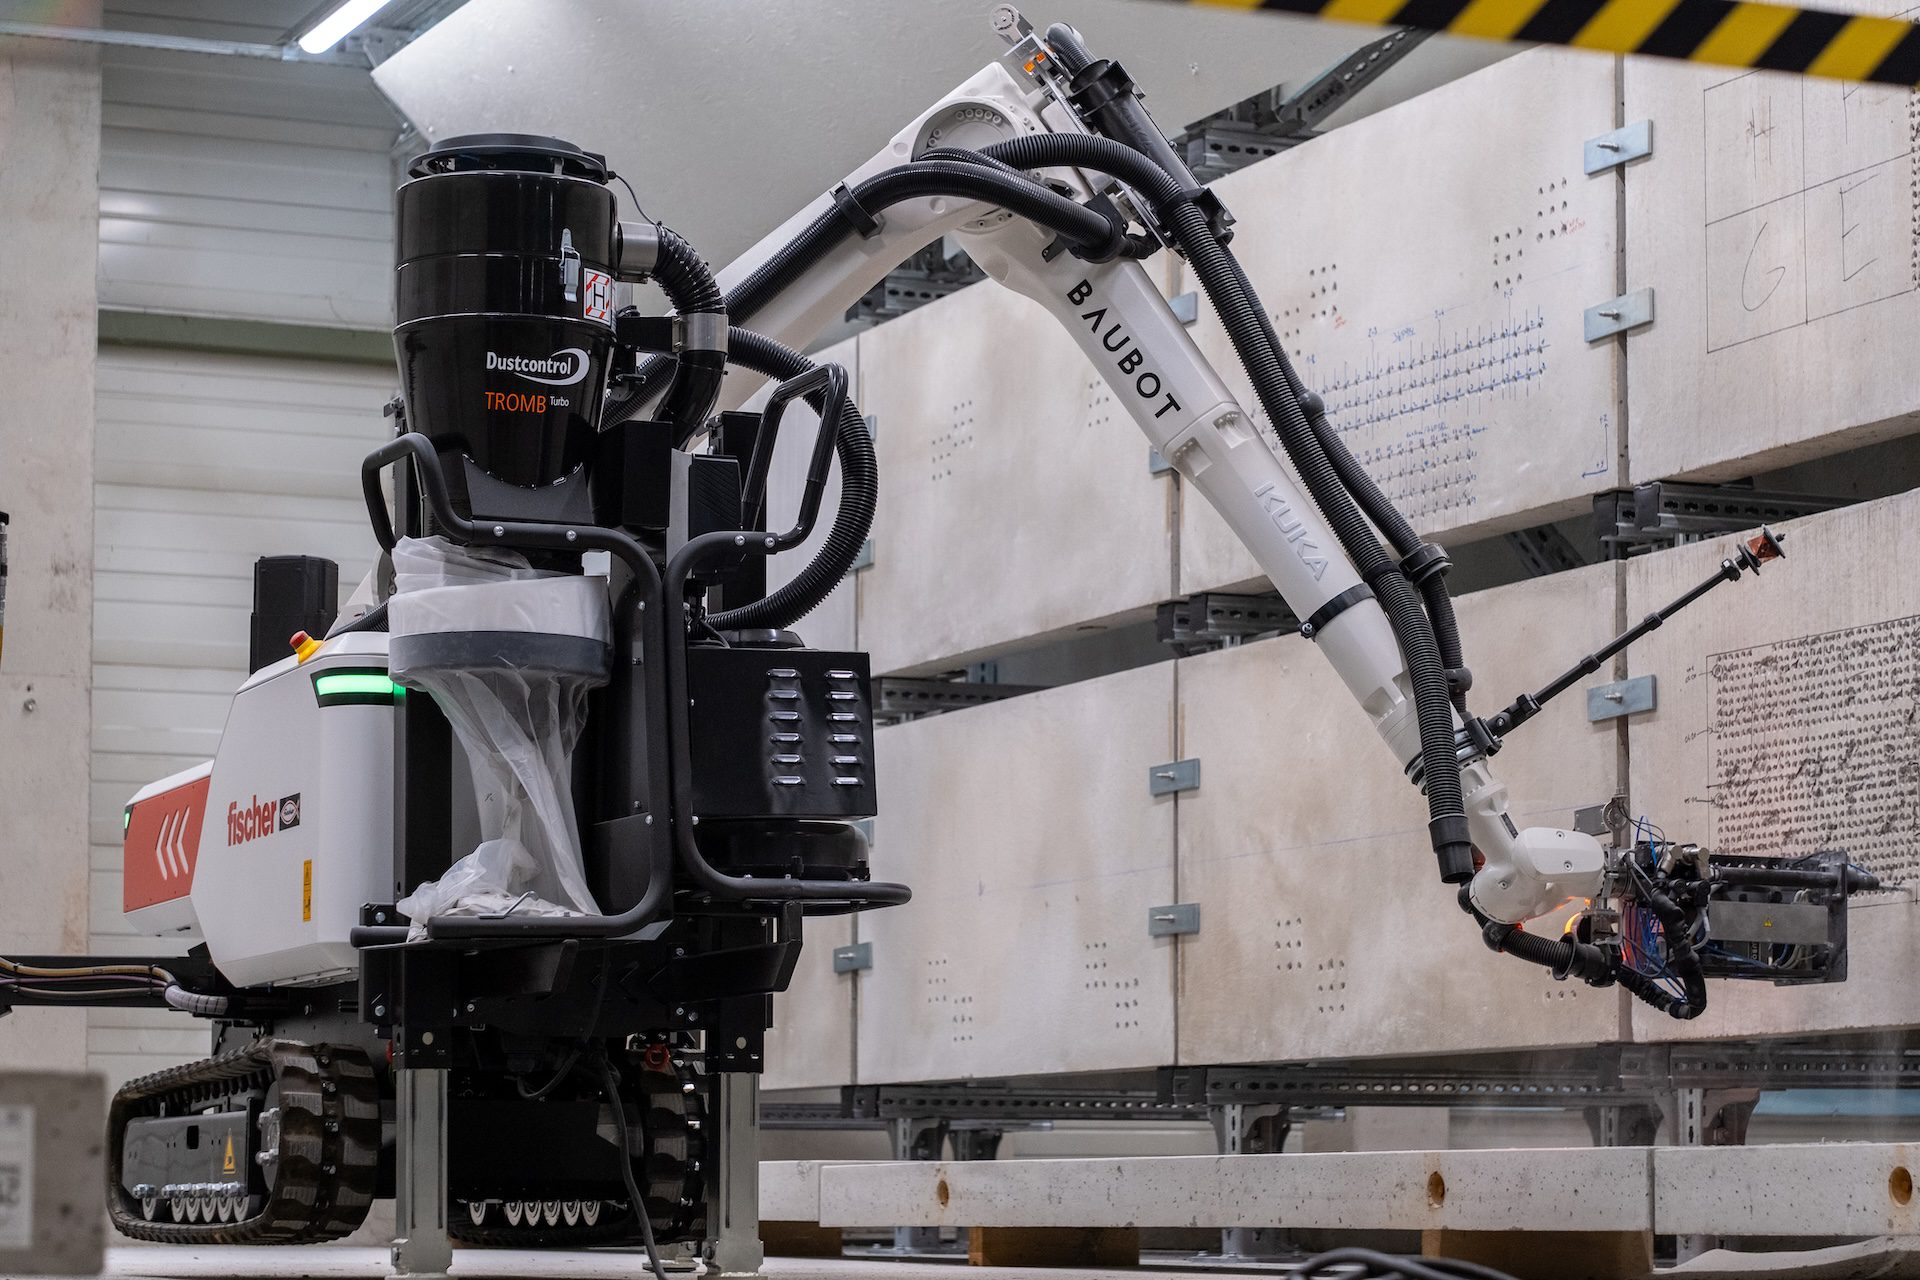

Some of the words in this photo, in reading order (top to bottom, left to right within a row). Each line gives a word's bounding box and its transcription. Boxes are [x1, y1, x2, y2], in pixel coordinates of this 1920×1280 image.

[593, 283, 606, 310] H
[486, 351, 572, 375] Dustcontrol
[1067, 279, 1182, 420] BAUBOT
[485, 391, 547, 414] TROMB
[550, 395, 570, 407] Turbo
[1254, 480, 1329, 582] KUKA
[228, 795, 277, 846] fischer
